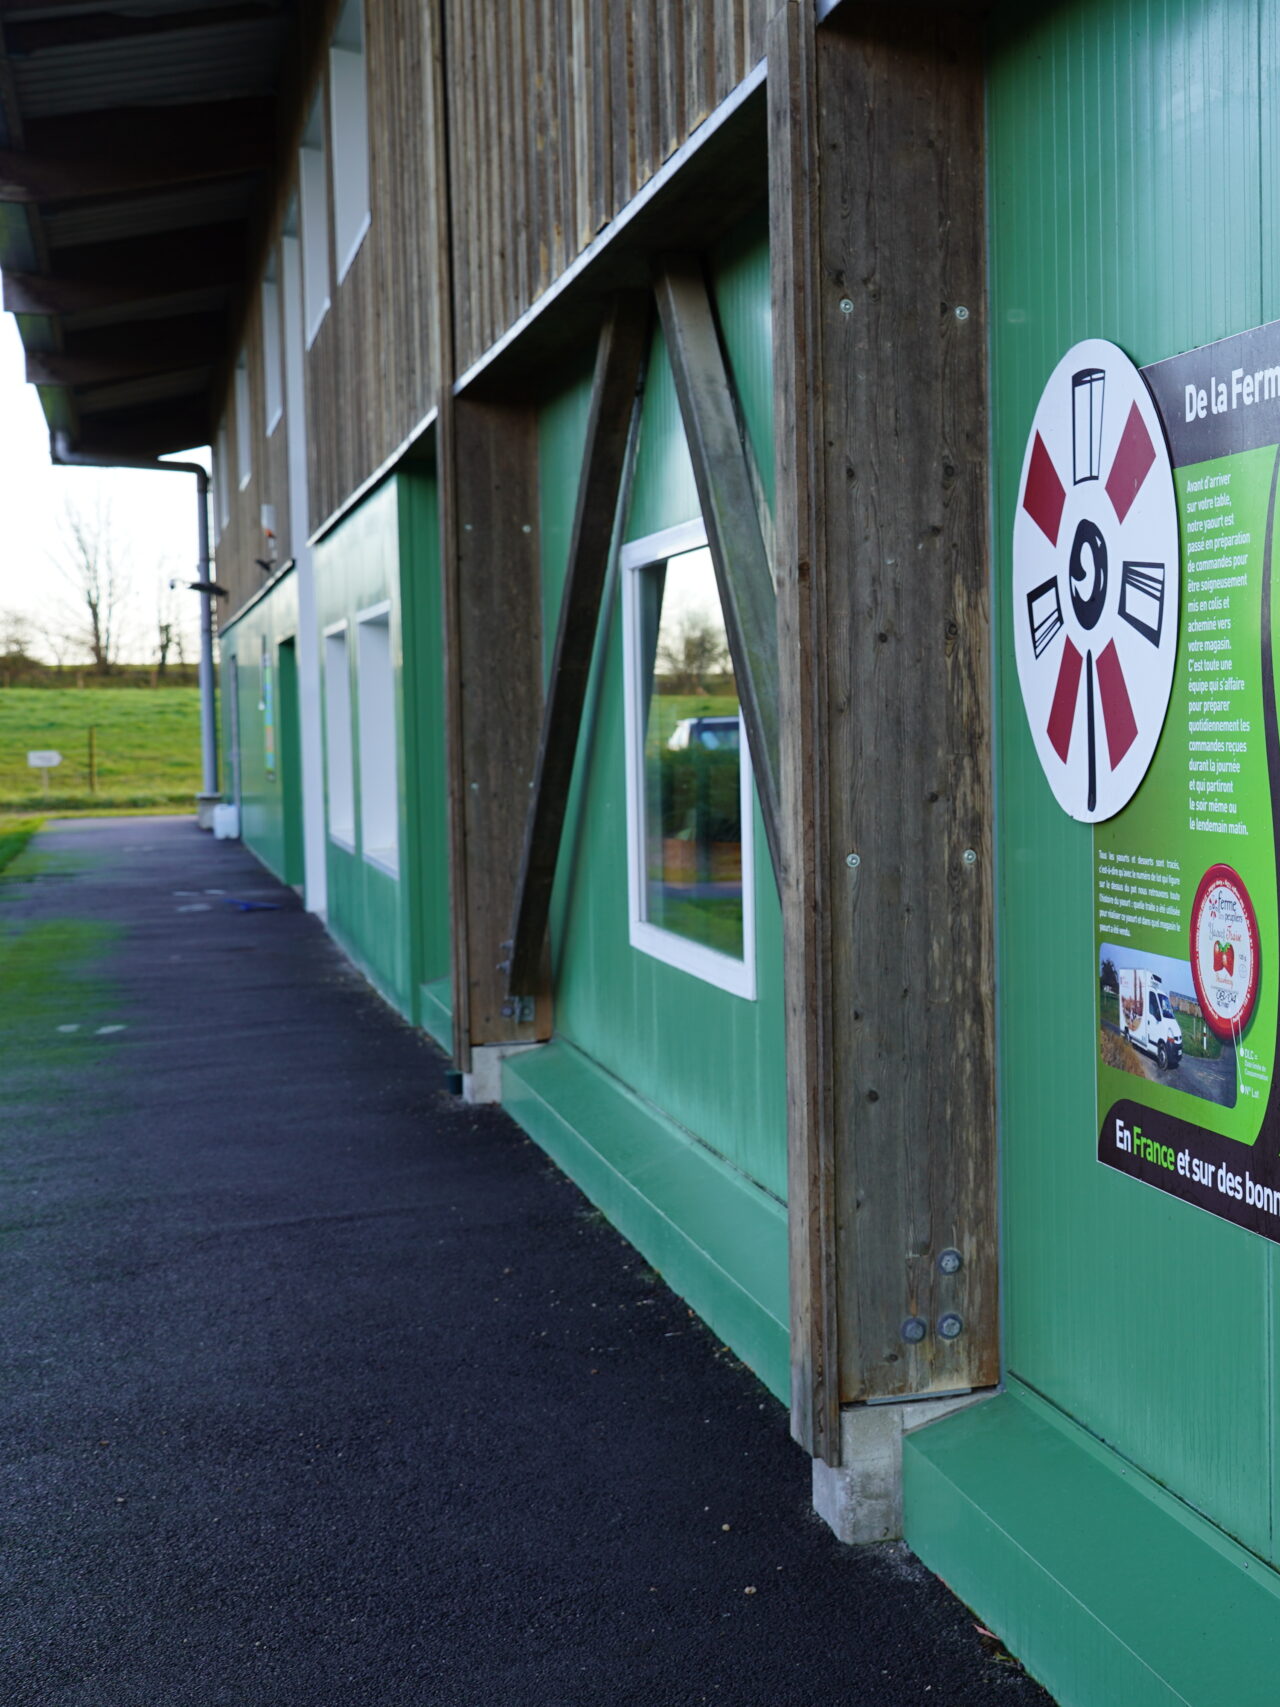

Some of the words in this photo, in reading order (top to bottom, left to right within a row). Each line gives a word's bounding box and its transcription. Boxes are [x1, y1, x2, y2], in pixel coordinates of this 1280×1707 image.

[1185, 383, 1207, 422] De
[1211, 376, 1227, 414] la
[1187, 480, 1203, 493] Avant
[1205, 474, 1231, 489] d'arriver
[1187, 502, 1196, 513] sur
[1198, 499, 1213, 511] votre
[1188, 521, 1203, 533] notre
[1204, 516, 1224, 534] yaourt
[1225, 514, 1234, 526] est
[1188, 537, 1204, 556] passé
[1206, 539, 1213, 550] en
[1214, 532, 1250, 552] préparation
[1188, 561, 1195, 573] de
[1196, 556, 1232, 572] commandes
[1233, 555, 1248, 570] pour
[1201, 575, 1247, 593] soigneusement
[1188, 600, 1199, 612] mis
[1200, 602, 1207, 611] en
[1209, 598, 1222, 610] colis
[1223, 598, 1230, 609] et
[1188, 617, 1216, 632] acheminé
[1218, 620, 1231, 630] vers
[1188, 641, 1204, 652] votre
[1188, 660, 1203, 672] C'est
[1204, 660, 1220, 671] toute
[1221, 661, 1232, 670] une
[1189, 679, 1208, 694] équipe
[1209, 678, 1219, 694] qui
[1189, 702, 1202, 714] pour
[1204, 698, 1230, 714] préparer
[1189, 720, 1239, 734] quotidiennement
[1241, 719, 1250, 732] les
[1189, 740, 1225, 752] commandes
[1226, 742, 1247, 755] reçues
[1189, 759, 1209, 771] durant
[1210, 760, 1216, 772] la
[1216, 759, 1240, 775] journée
[1190, 780, 1195, 790] et
[1196, 780, 1205, 794] qui
[1207, 780, 1233, 794] partiront
[1190, 798, 1195, 810] le
[1196, 799, 1208, 811] soir
[1229, 804, 1237, 814] ou
[1190, 818, 1195, 830] le
[1196, 818, 1228, 833] lendemain
[1115, 1119, 1131, 1153] En
[1133, 1127, 1175, 1171] France
[1177, 1151, 1190, 1177] et
[1192, 1157, 1214, 1185] sur
[1217, 1162, 1243, 1200] des
